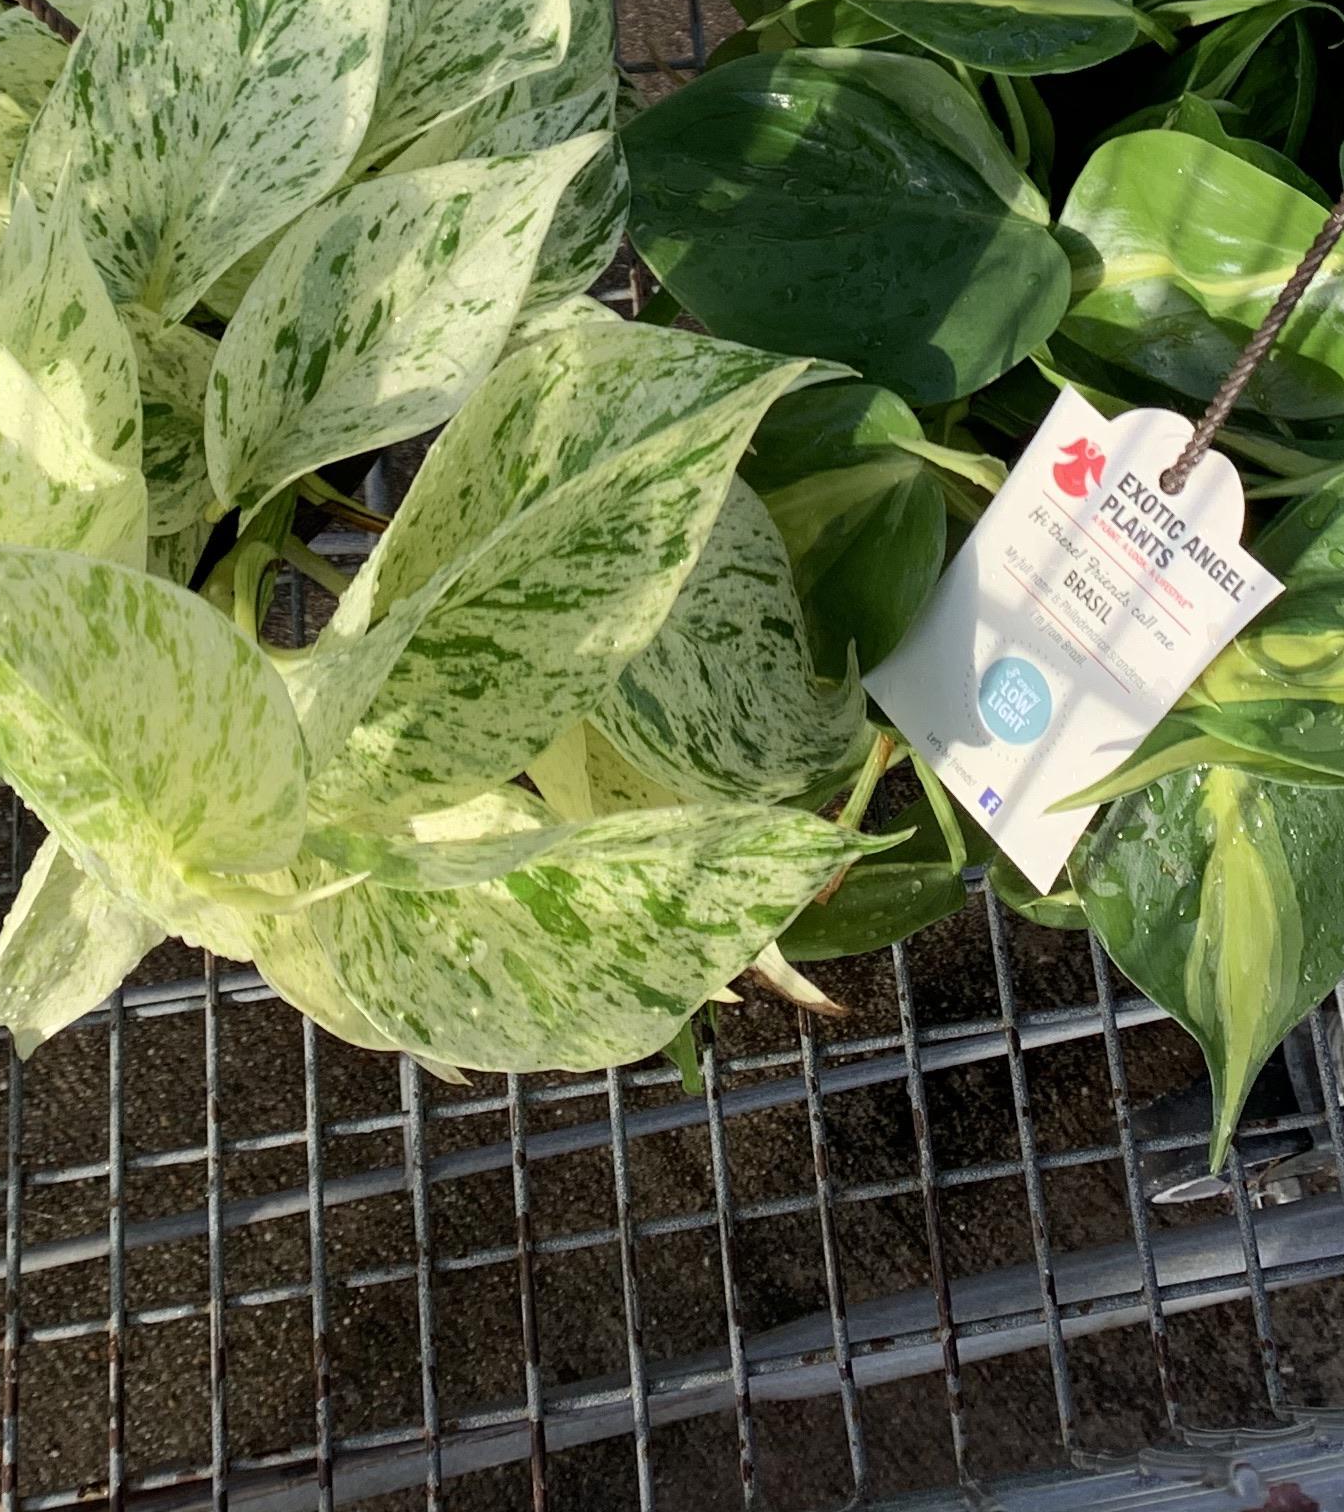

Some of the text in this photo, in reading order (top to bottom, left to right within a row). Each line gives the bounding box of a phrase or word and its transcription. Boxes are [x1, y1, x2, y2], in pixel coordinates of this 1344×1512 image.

[1100, 494, 1174, 569] PLANTS
[1118, 472, 1249, 603] EXOTIC ANGEL
[1029, 504, 1174, 653] Hi there! Friends call me
[1063, 569, 1113, 625] BRASIL
[988, 691, 1027, 734] LIGHT
[1000, 680, 1033, 716] LOW
